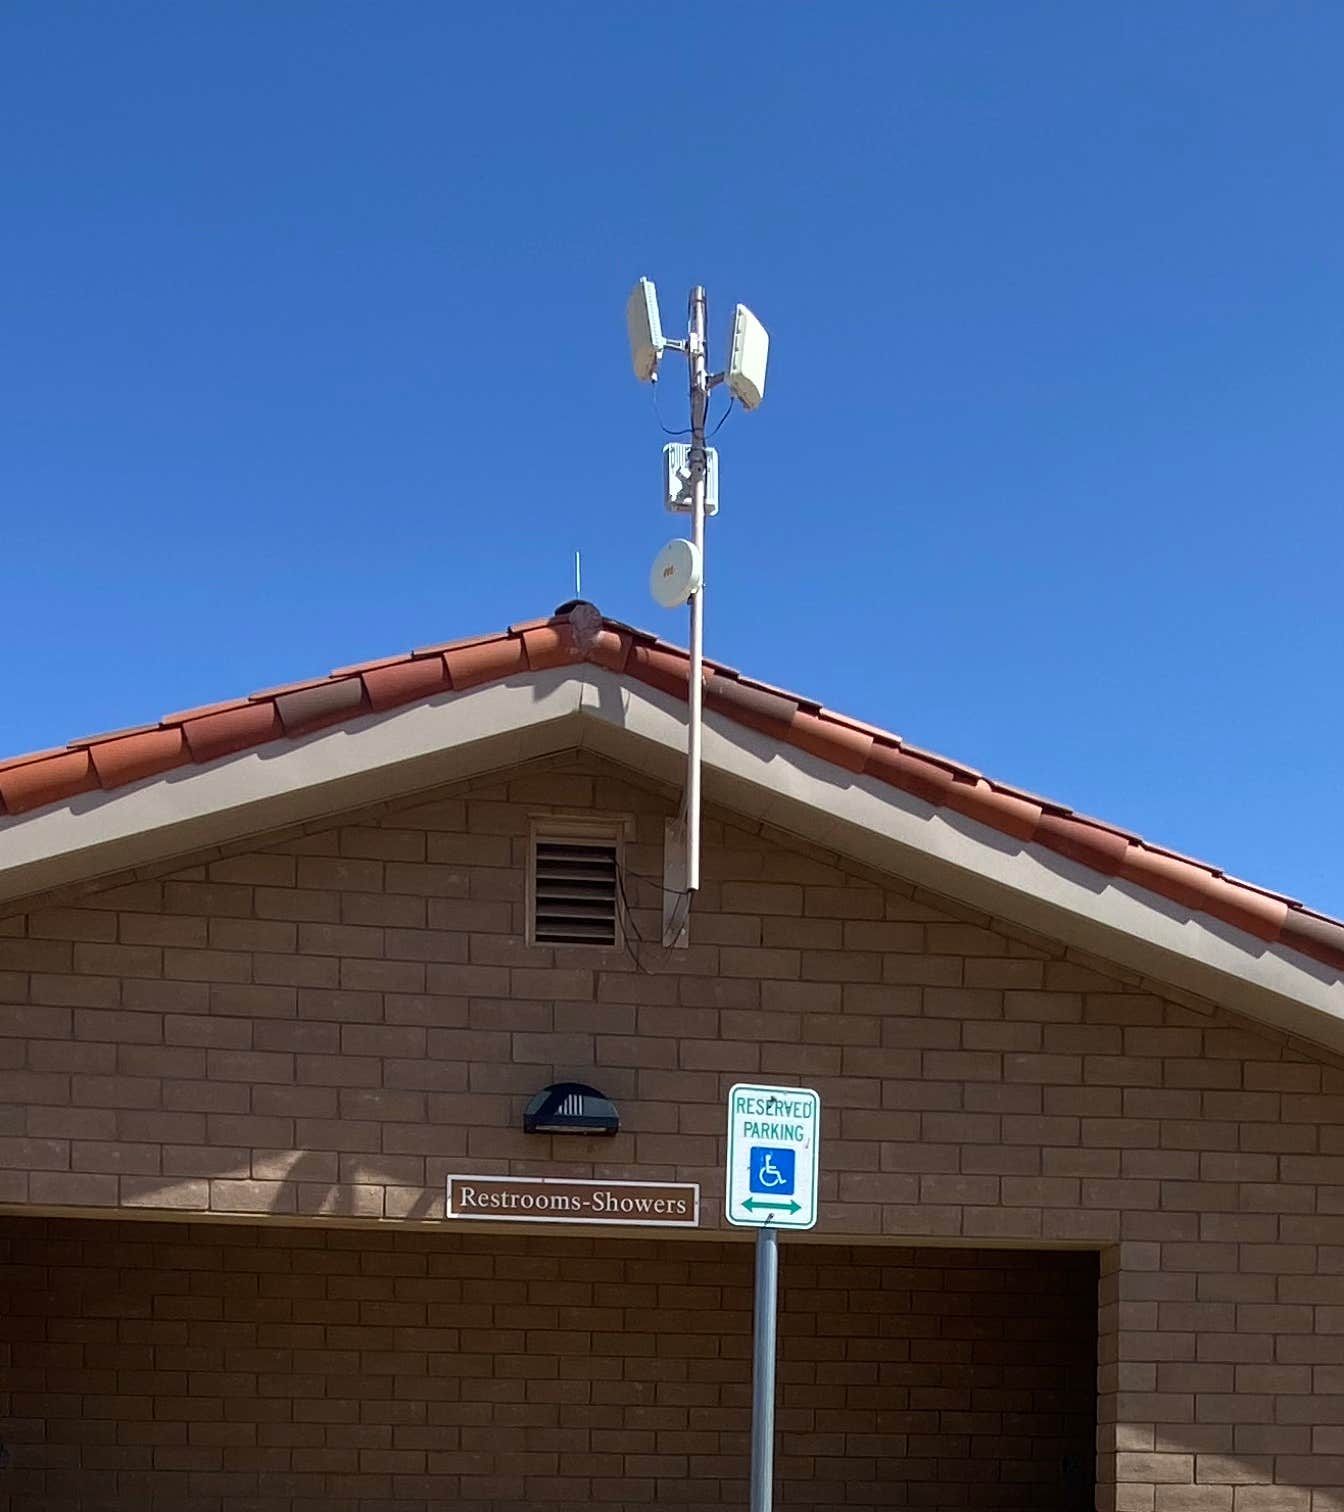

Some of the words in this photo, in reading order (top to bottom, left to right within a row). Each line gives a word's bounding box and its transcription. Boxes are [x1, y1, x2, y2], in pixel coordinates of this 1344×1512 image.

[736, 1097, 812, 1119] RESERVED
[743, 1121, 804, 1142] PARKING
[459, 1186, 687, 1215] Restrooms-Showers
